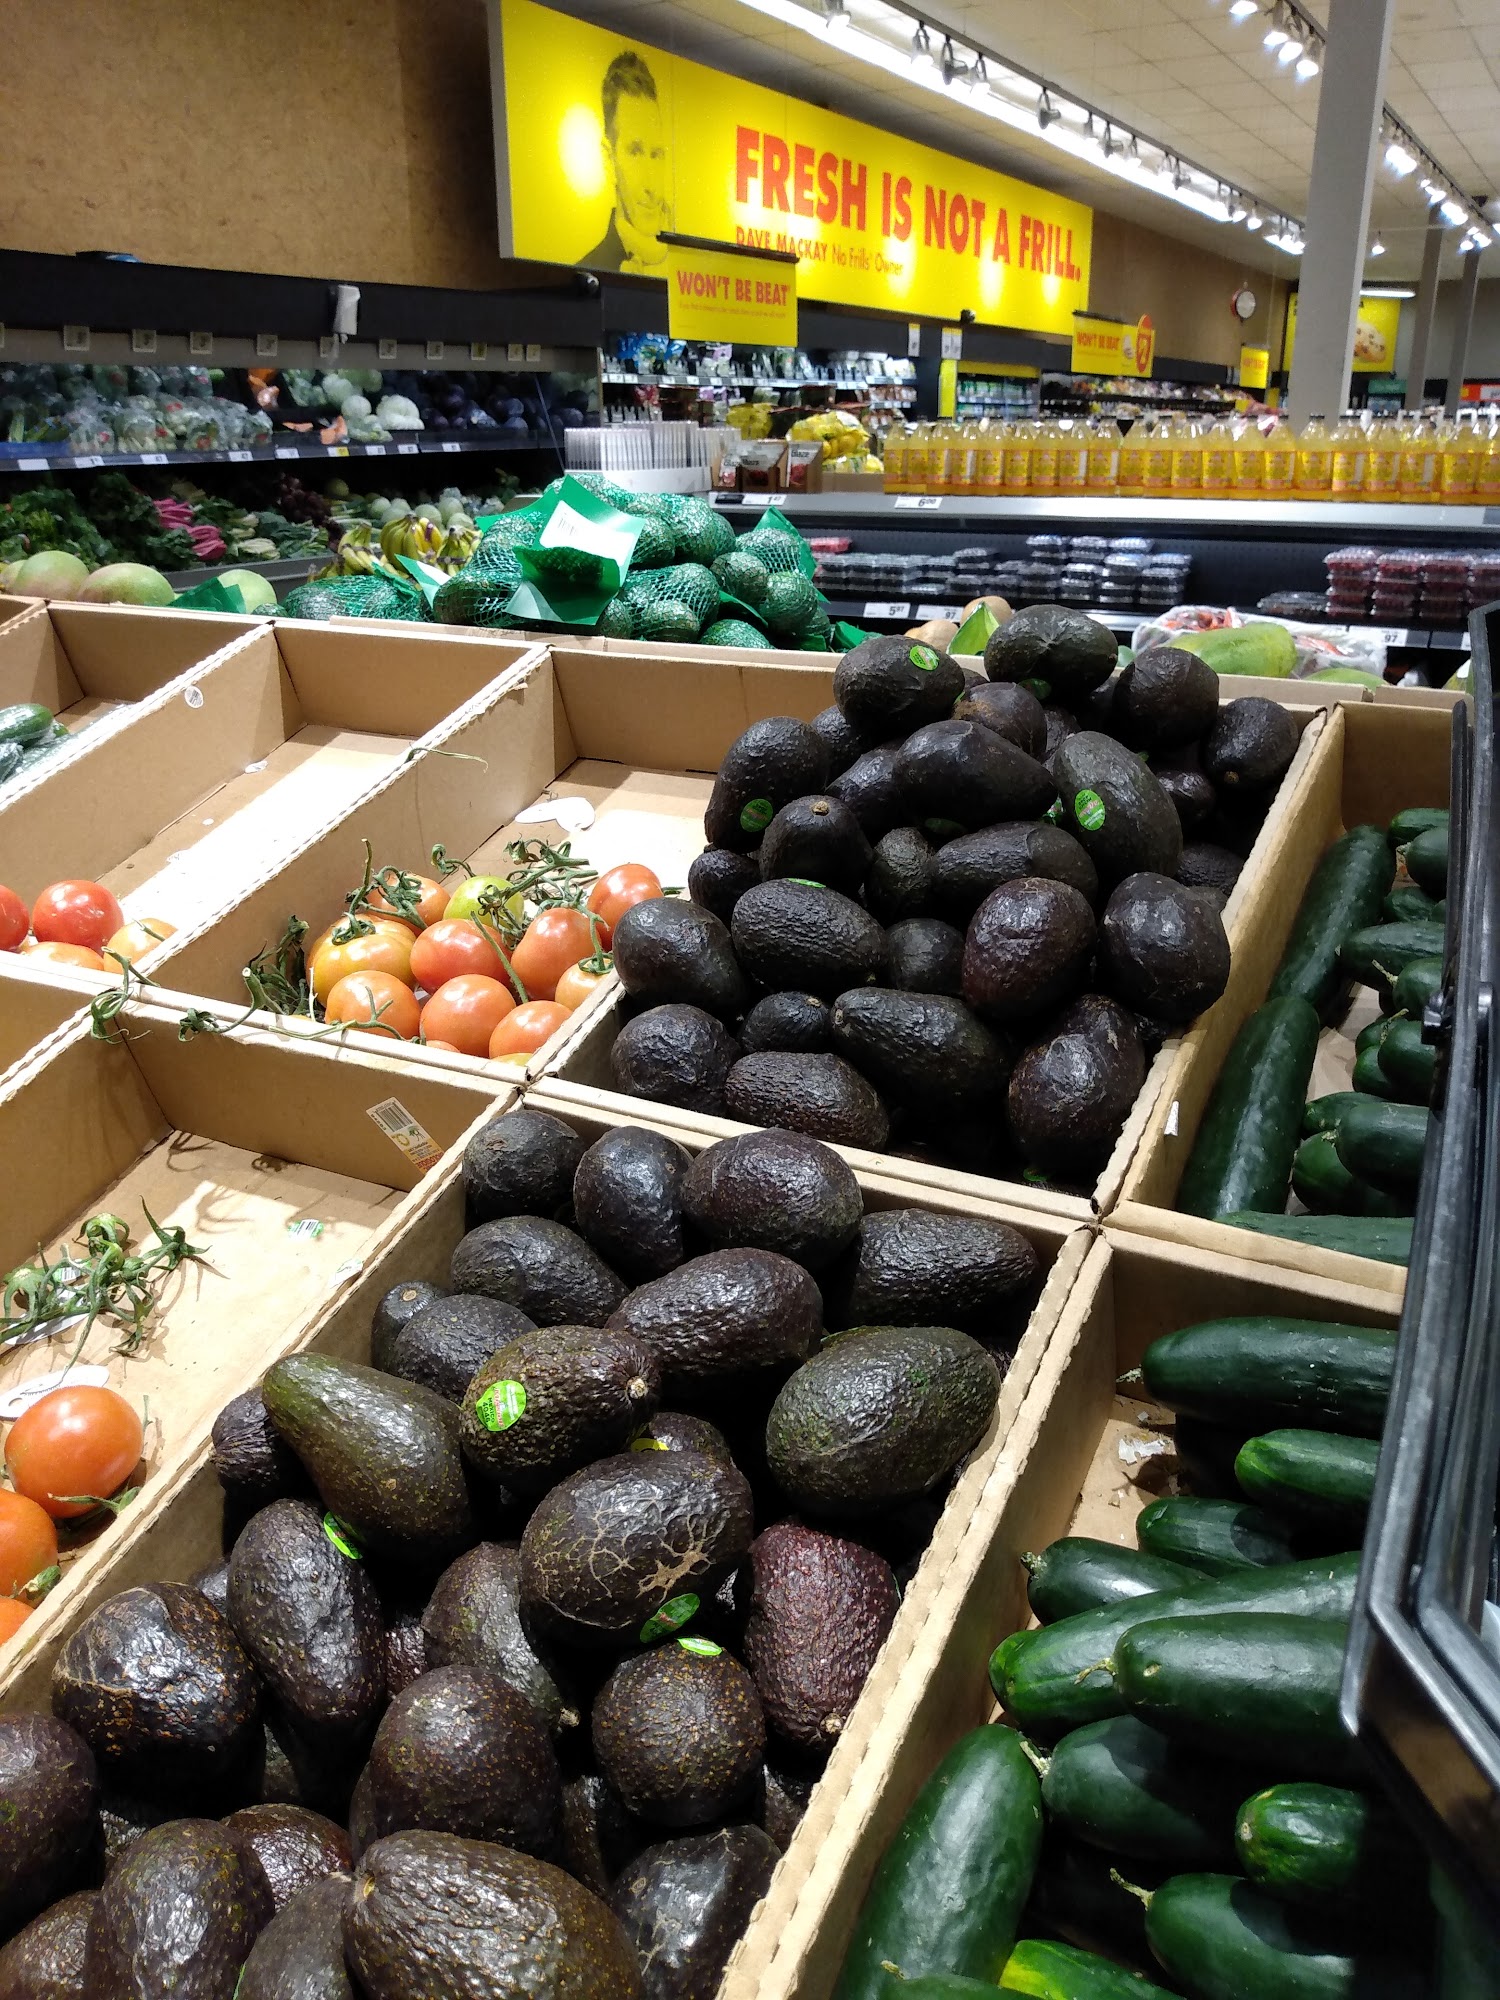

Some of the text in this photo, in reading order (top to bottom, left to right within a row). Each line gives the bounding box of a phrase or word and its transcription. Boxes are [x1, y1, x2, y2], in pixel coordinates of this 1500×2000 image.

[736, 125, 1081, 282] FRESH IS NOT A FRILL.
[736, 226, 771, 249] DAVE
[776, 233, 828, 262] MACKAY
[832, 244, 847, 266] No
[875, 252, 903, 276] Owner
[677, 270, 730, 300] WON'T
[735, 278, 751, 302] BE
